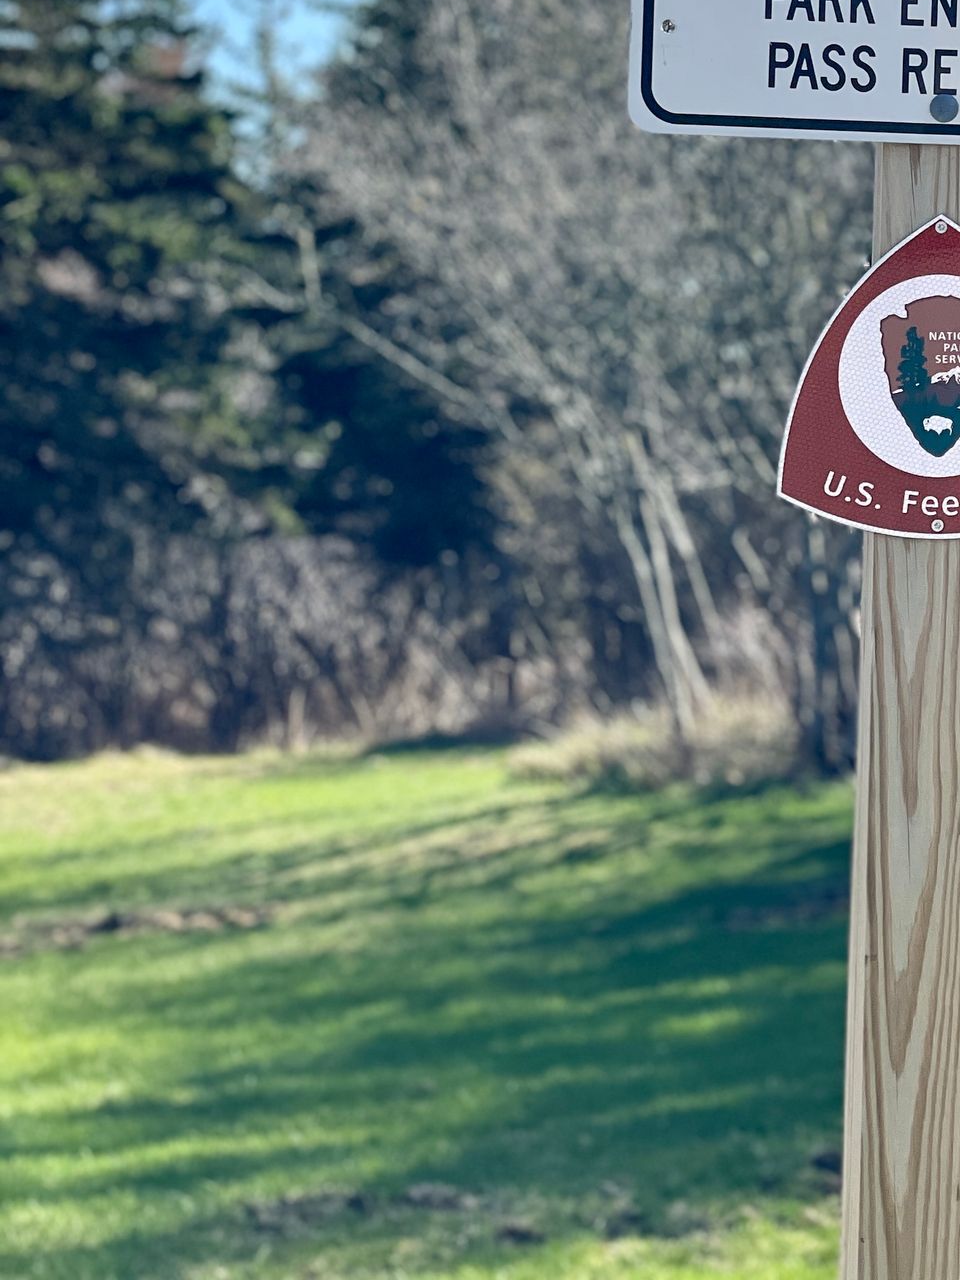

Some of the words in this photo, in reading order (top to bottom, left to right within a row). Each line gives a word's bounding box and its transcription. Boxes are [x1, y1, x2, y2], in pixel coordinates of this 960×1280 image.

[768, 41, 877, 93] PASS
[822, 470, 881, 511] U.S.
[901, 488, 960, 517] Fee
